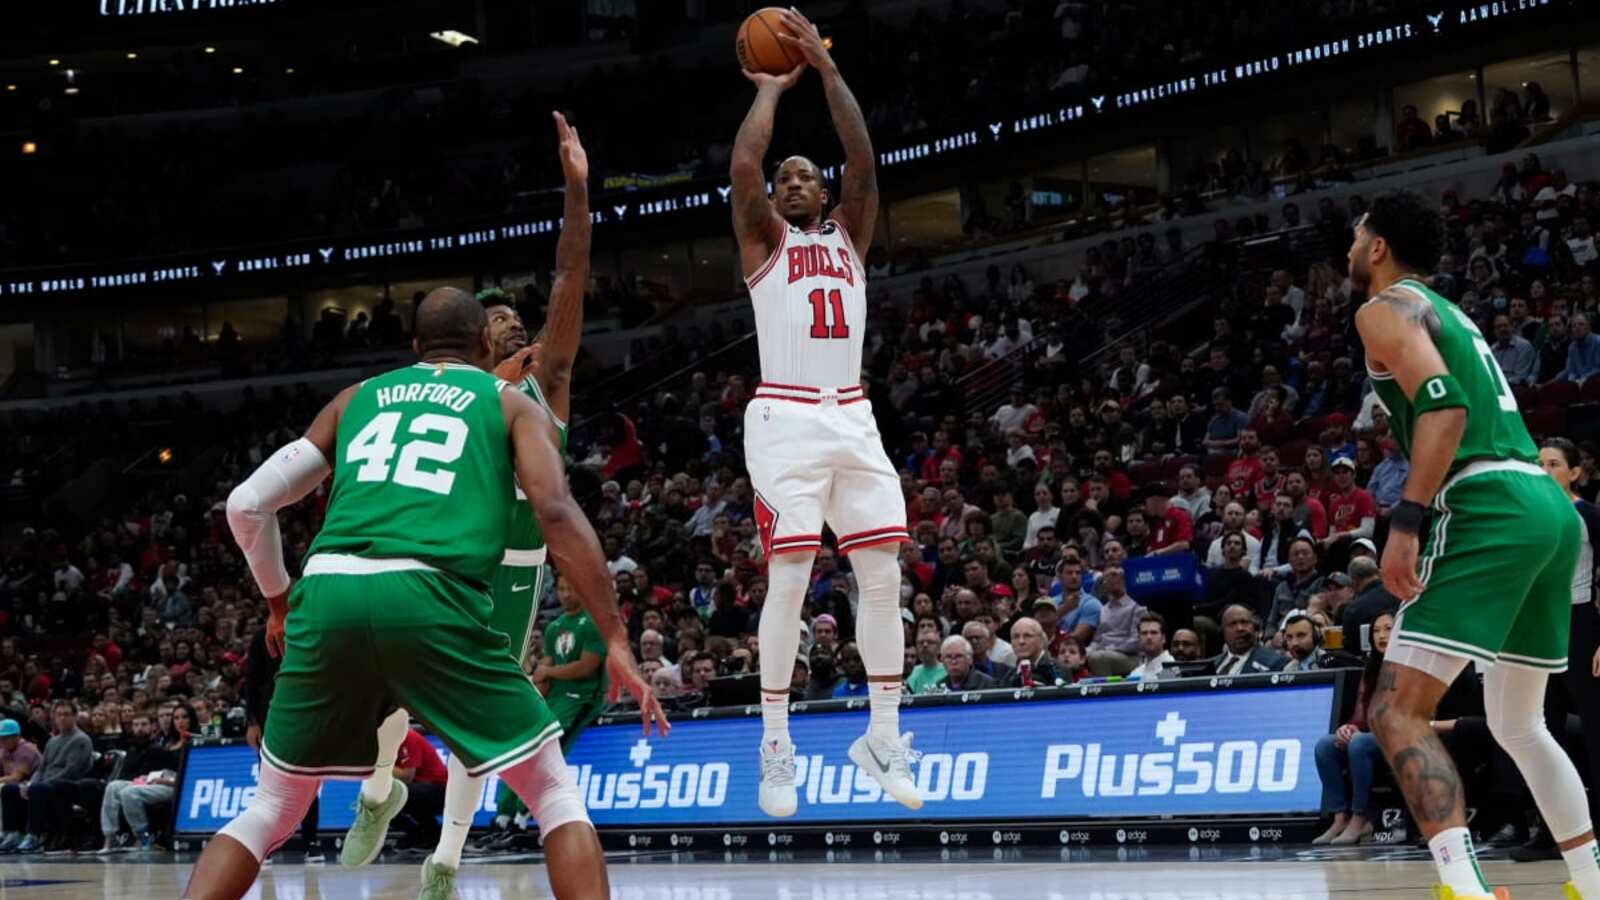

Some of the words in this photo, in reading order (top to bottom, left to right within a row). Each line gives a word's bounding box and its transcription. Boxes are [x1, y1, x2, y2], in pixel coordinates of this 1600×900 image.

[1116, 76, 1196, 108] CONNECTING
[1204, 69, 1227, 86] THE
[1235, 56, 1279, 79] WORLD
[1287, 38, 1349, 66] THROUGH
[881, 143, 930, 166] THROUGH
[344, 239, 423, 260] CONNECTING
[430, 236, 453, 249] THE
[458, 229, 496, 246] WORLD
[501, 220, 553, 238] THROUGH
[9, 281, 33, 294] THE
[41, 277, 85, 292] WORLD
[91, 272, 147, 287] THROUGH
[787, 243, 854, 287] BULLS
[808, 288, 849, 339] 11
[376, 382, 477, 413] HORFORD
[1426, 377, 1447, 399] 0
[345, 411, 470, 496] 42
[1041, 738, 1301, 799] Plus500
[1070, 831, 1091, 844] edge
[1128, 830, 1148, 843] edge
[1200, 828, 1220, 842] edge
[1261, 828, 1283, 841] edge
